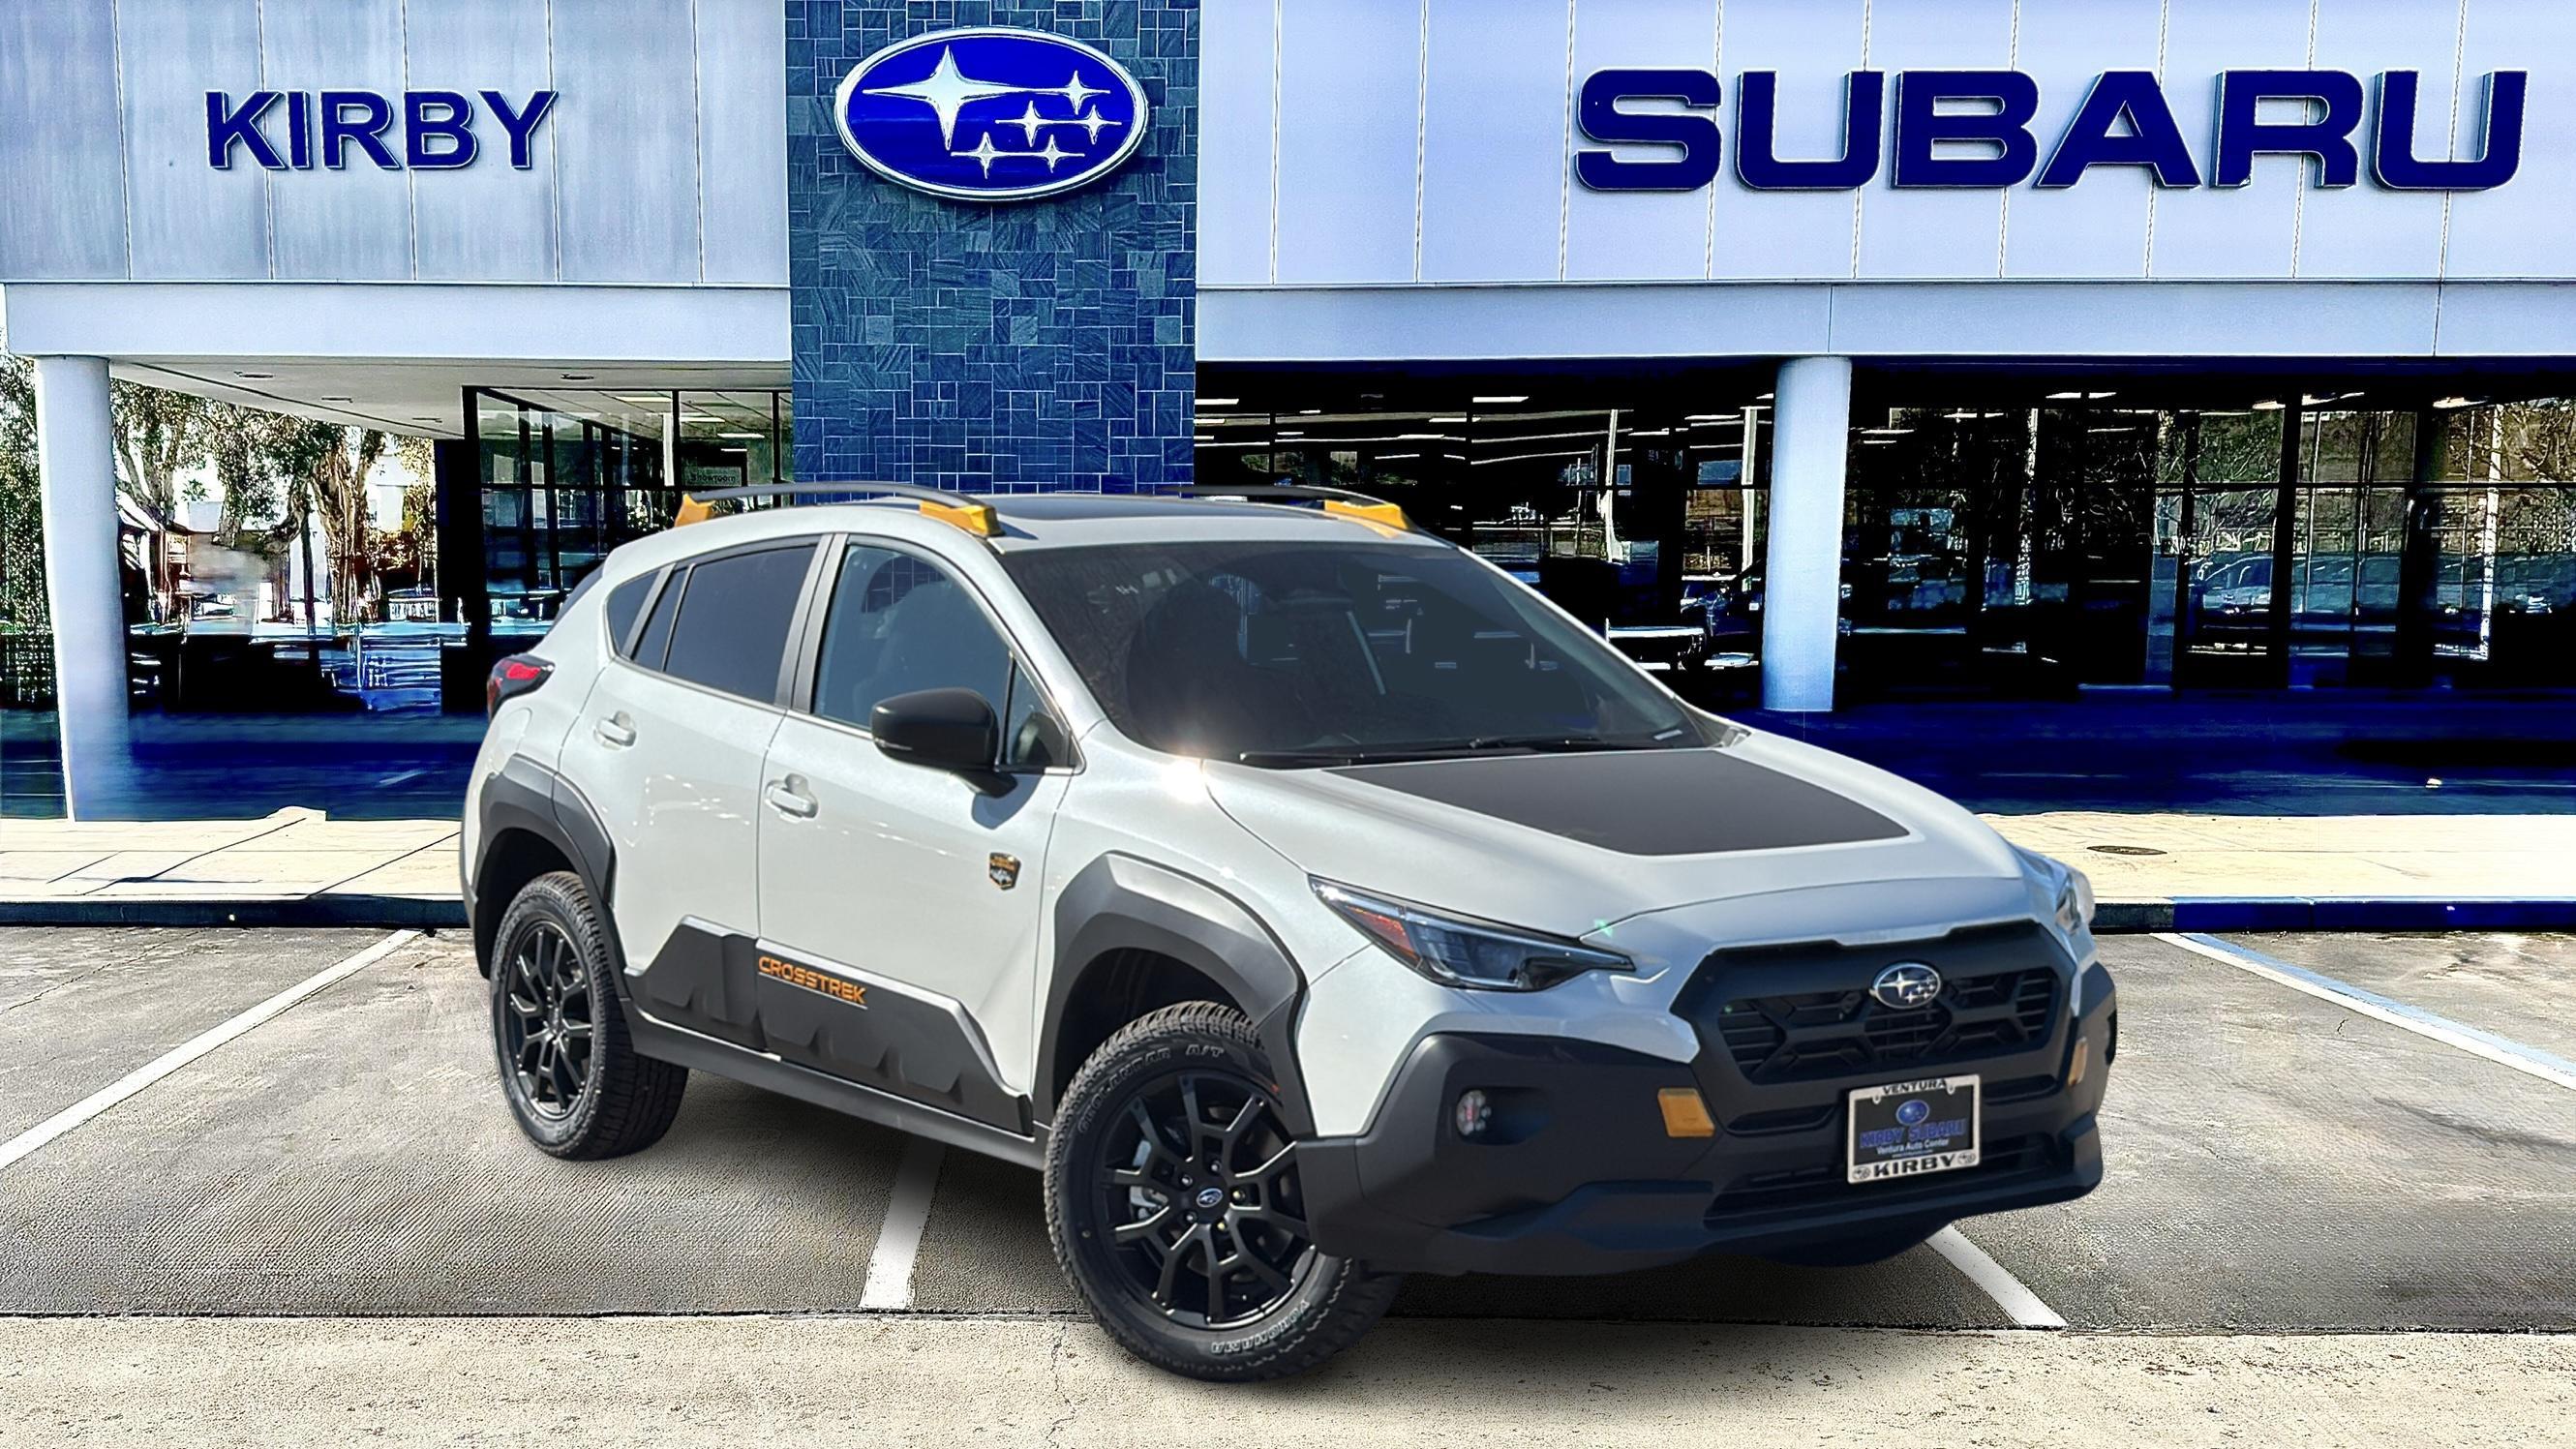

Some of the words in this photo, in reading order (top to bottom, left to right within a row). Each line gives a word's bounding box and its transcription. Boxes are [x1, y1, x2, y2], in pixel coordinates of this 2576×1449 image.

[205, 90, 559, 170] KIRBY
[1575, 70, 2528, 192] SUBARU
[758, 955, 866, 1005] CROSSTREK
[1882, 1078, 1947, 1095] VENTURA
[1860, 1127, 1905, 1149] KIRBY
[1908, 1118, 1967, 1141] SUBARU
[1876, 1143, 1904, 1155] Ventura
[1905, 1141, 1924, 1151] Auto
[1924, 1138, 1950, 1149] Center
[1873, 1154, 1955, 1177] KIRBY
[1211, 1299, 1310, 1354] YOKOHAMA
